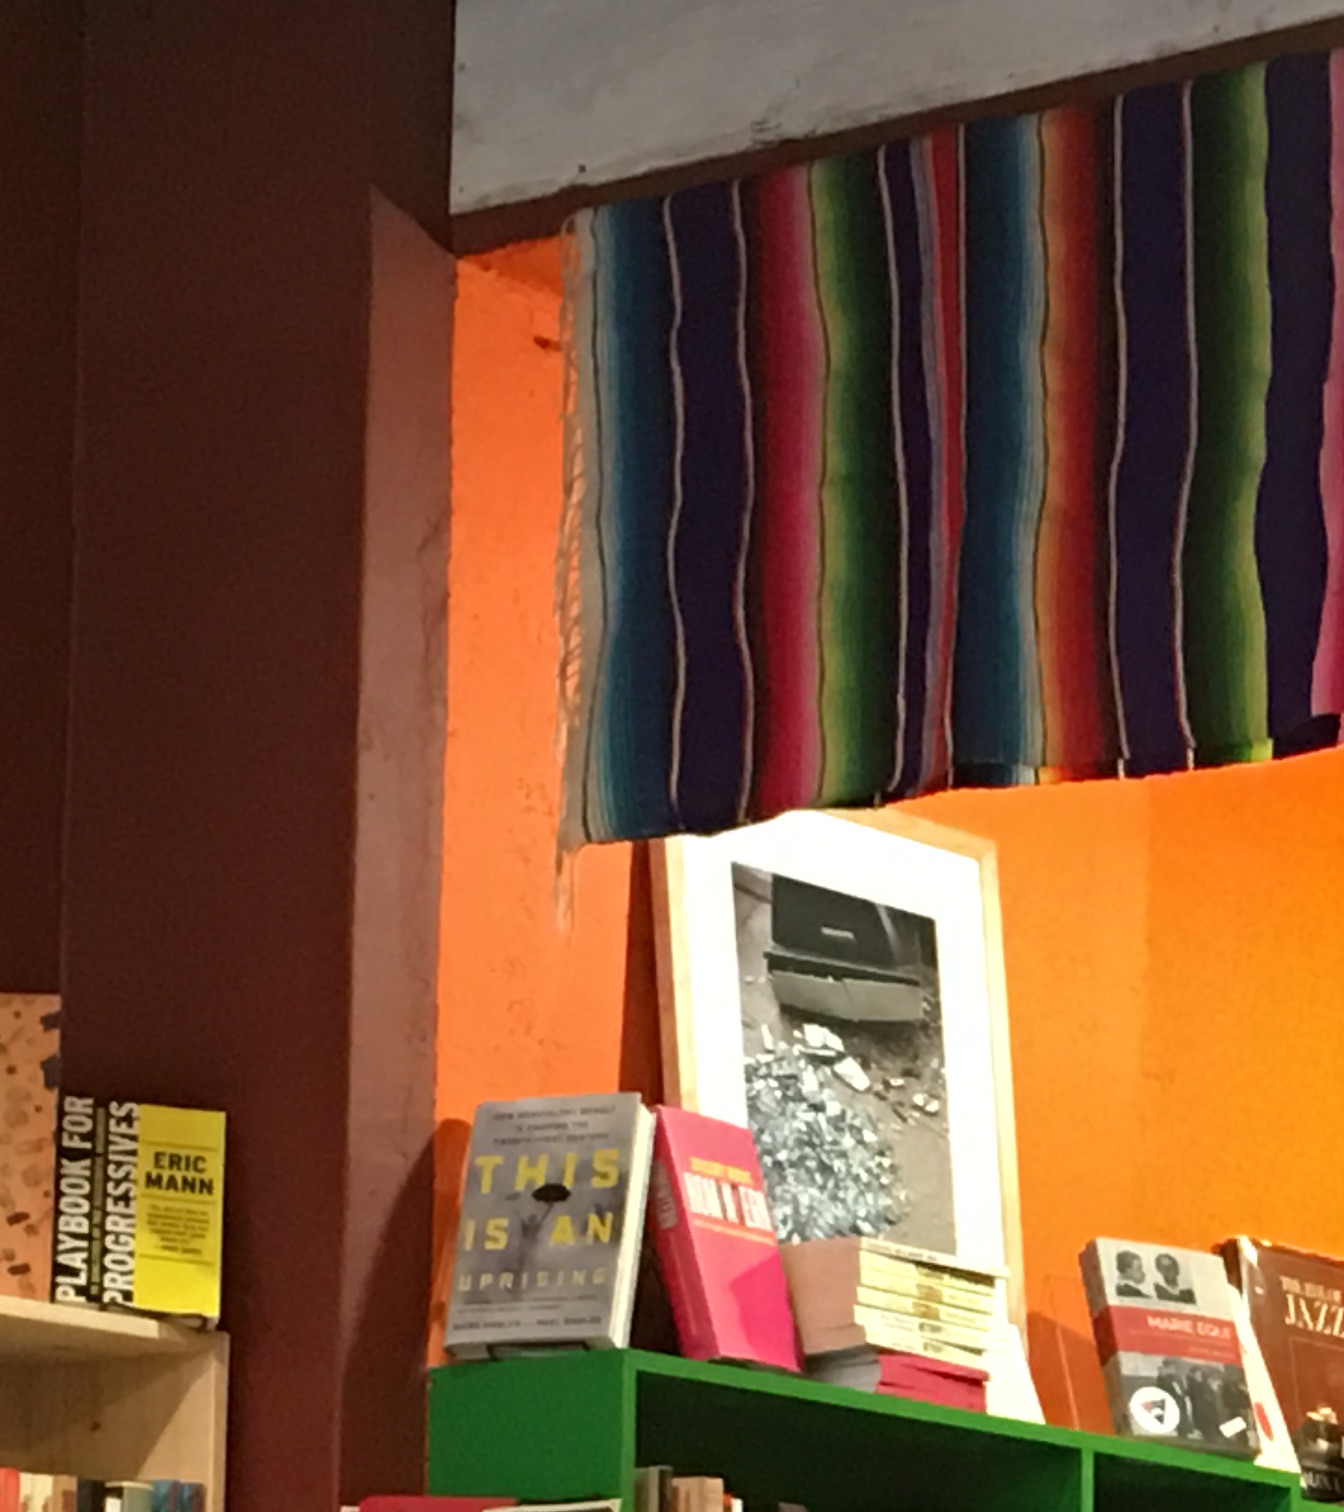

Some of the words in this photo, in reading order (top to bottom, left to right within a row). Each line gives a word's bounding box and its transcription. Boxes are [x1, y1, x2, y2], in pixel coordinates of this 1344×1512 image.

[62, 1095, 94, 1150] FOR
[145, 1171, 214, 1196] MANN
[153, 1151, 208, 1174] ERIC
[475, 1148, 620, 1195] THIS
[103, 1100, 140, 1308] PROGRESSIVES
[55, 1157, 92, 1304] PLAYBOOK
[463, 1217, 509, 1251] IS
[551, 1211, 614, 1246] AN
[457, 1267, 608, 1292] UPRISING
